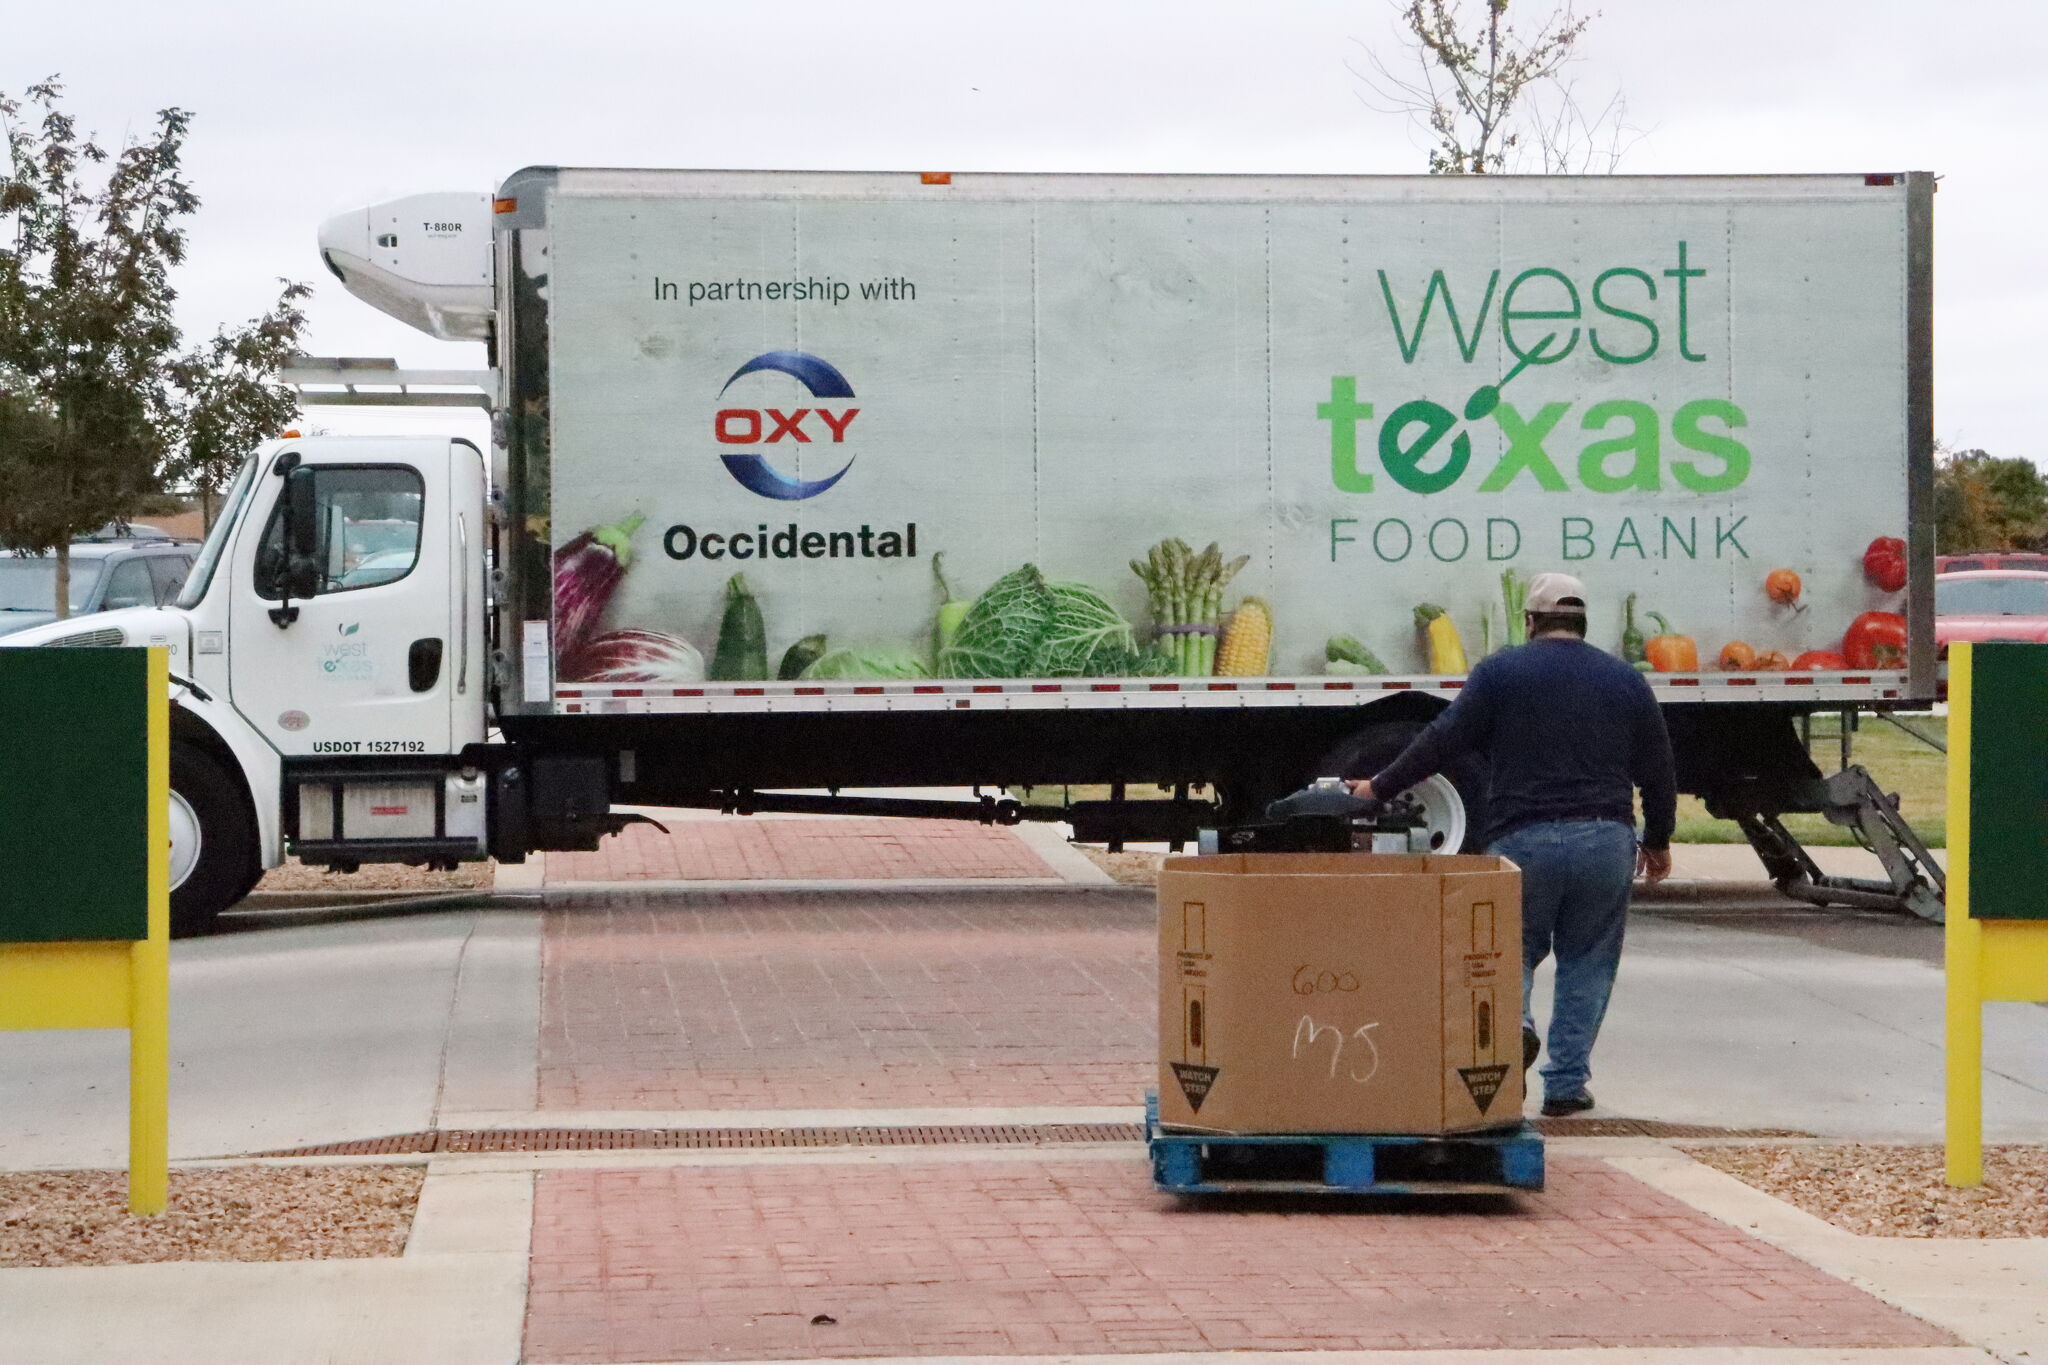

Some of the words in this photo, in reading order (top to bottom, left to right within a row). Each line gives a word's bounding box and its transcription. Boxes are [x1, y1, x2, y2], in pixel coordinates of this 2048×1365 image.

[423, 222, 462, 232] T-880R
[655, 277, 678, 300] In
[689, 276, 850, 306] partnership
[860, 277, 916, 300] with
[1377, 240, 1706, 364] west
[715, 408, 860, 444] OXY
[1317, 376, 1751, 494] texas
[663, 523, 917, 560] Occidental
[1331, 517, 1522, 562] FOOD
[1562, 516, 1750, 561] BANK
[313, 741, 361, 752] USDOT
[367, 741, 425, 752] 1527192
[1293, 964, 1360, 995] 600
[1180, 1070, 1211, 1082] WATCH
[1184, 1083, 1207, 1095] STEP
[1468, 1071, 1501, 1083] WATCH
[1472, 1084, 1496, 1096] STEP
